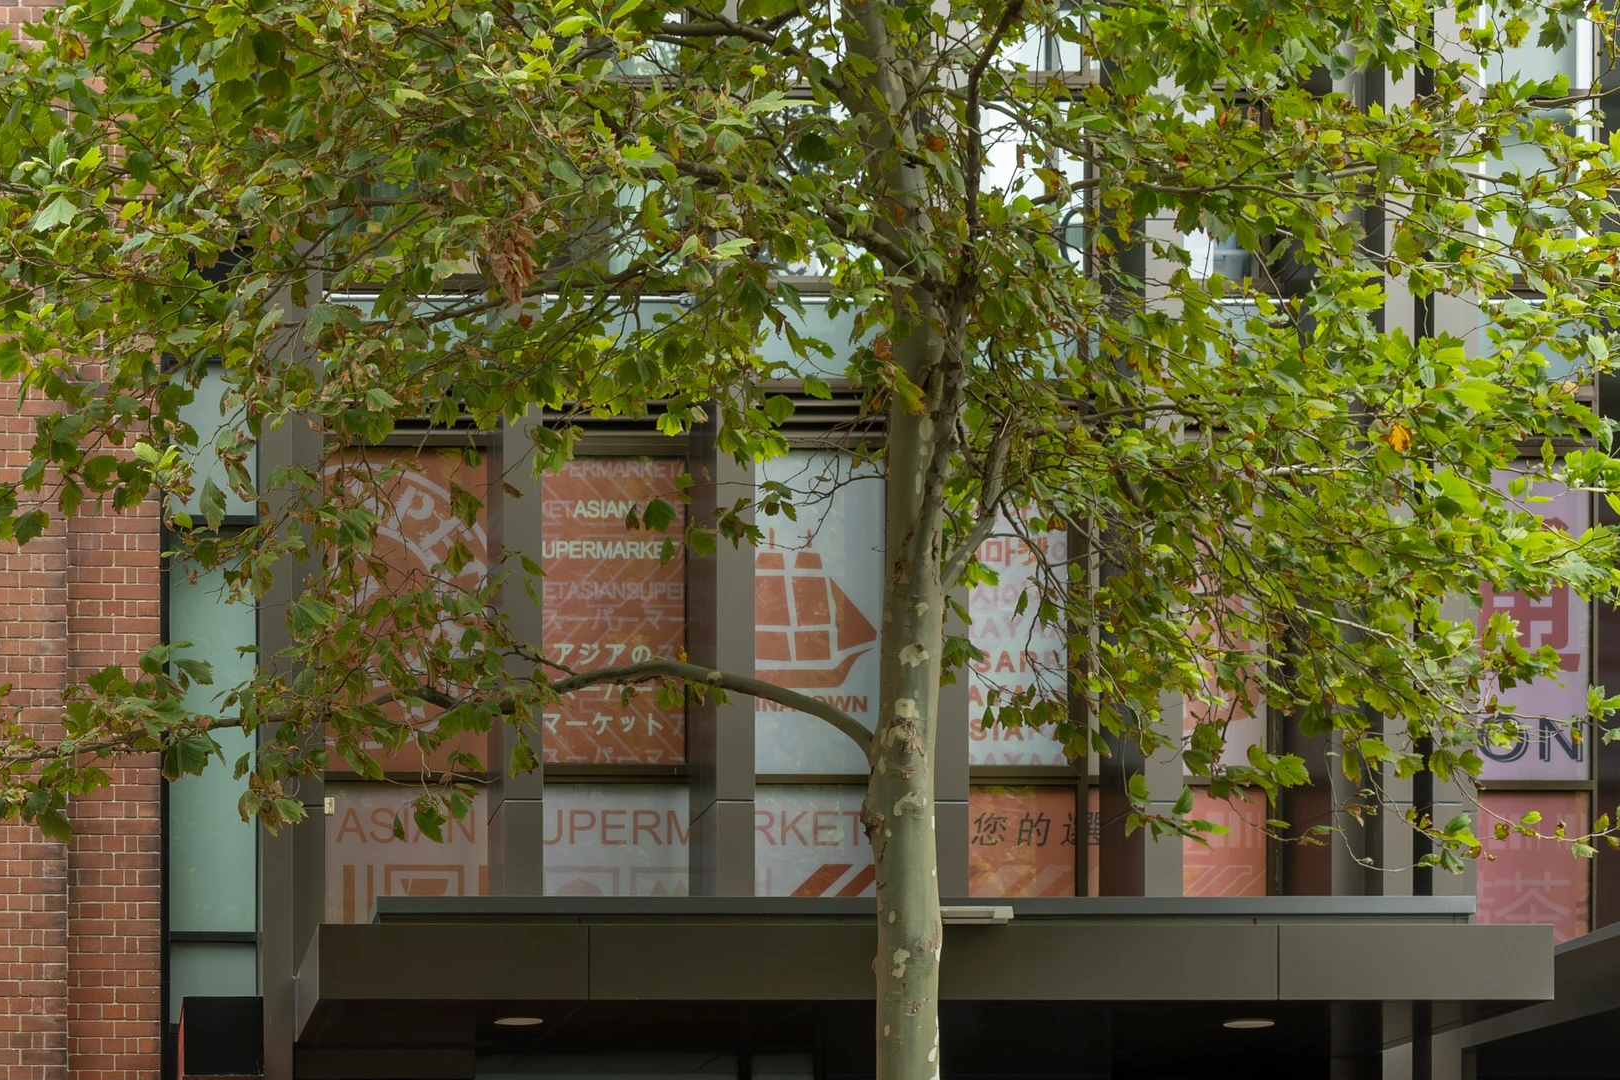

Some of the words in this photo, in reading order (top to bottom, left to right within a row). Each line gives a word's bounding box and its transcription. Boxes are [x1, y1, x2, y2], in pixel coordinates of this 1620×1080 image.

[554, 643, 651, 666] アジアの
[543, 712, 664, 737] マーケット
